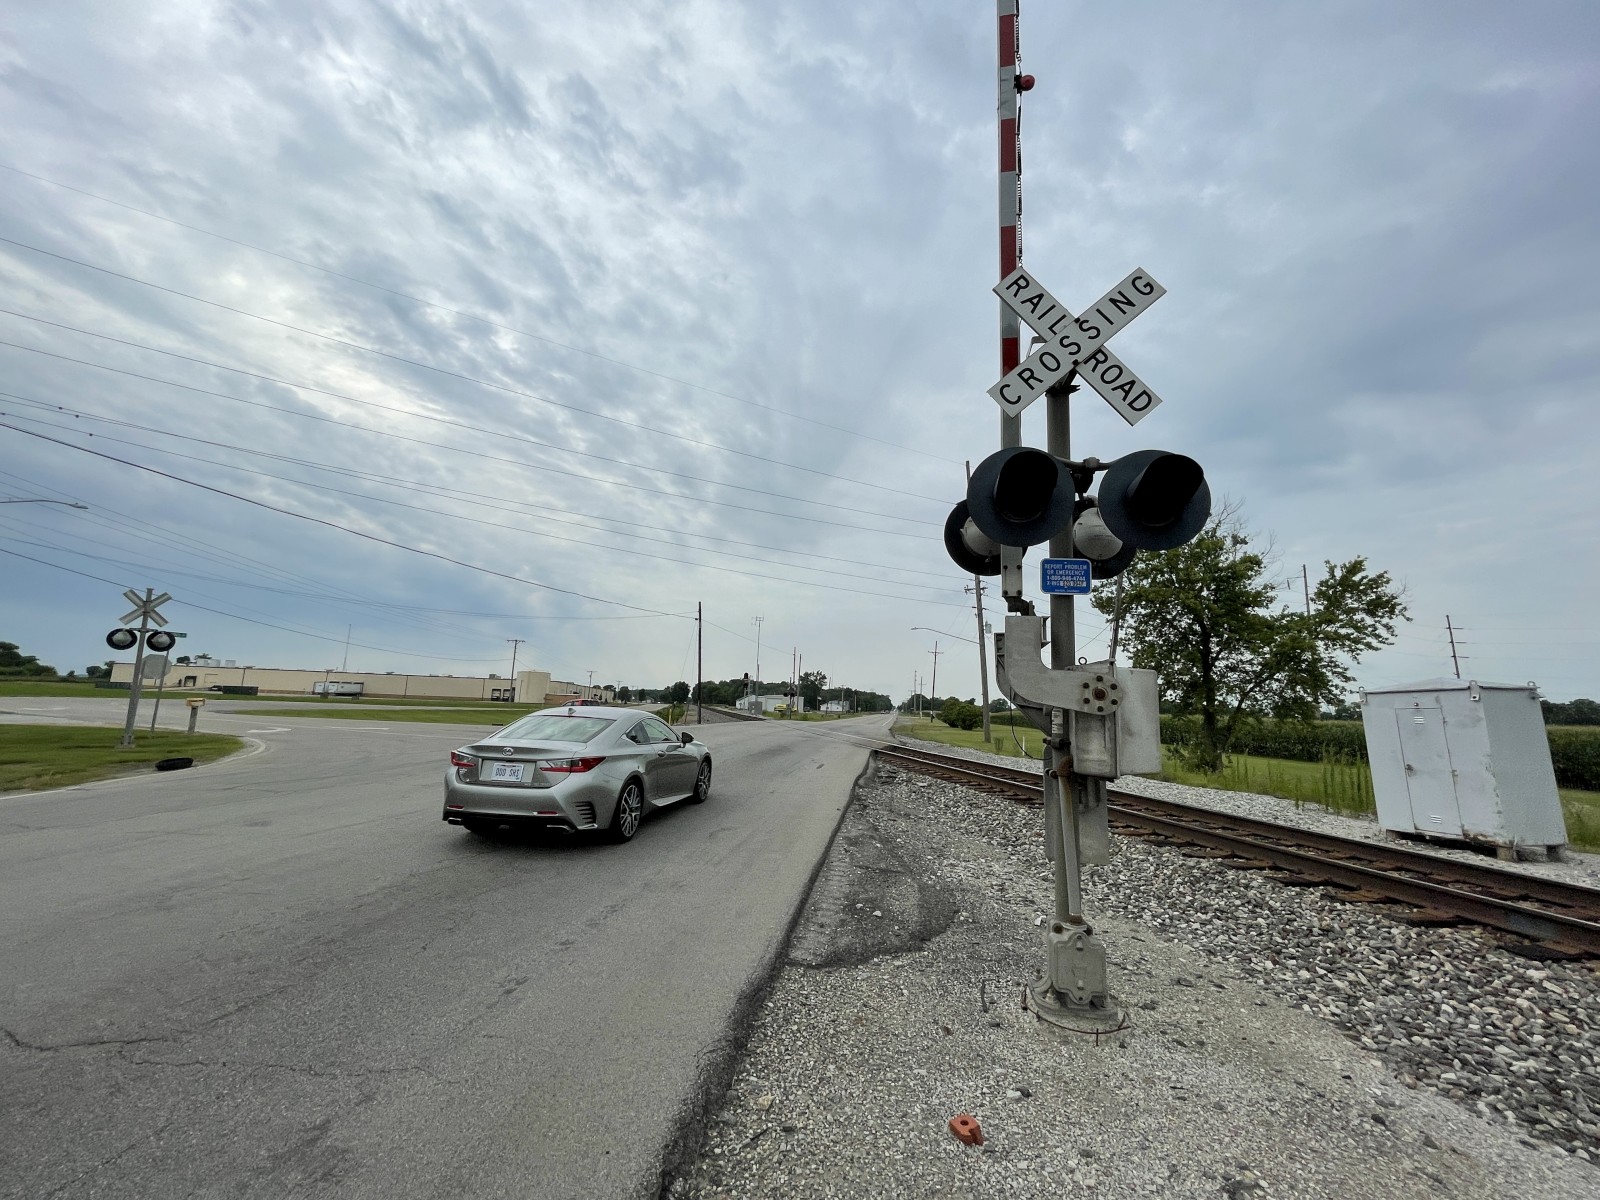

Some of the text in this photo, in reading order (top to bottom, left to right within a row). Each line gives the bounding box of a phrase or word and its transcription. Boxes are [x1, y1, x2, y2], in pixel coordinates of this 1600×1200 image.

[1005, 274, 1066, 335] RAIL
[999, 275, 1154, 405] CROSSING
[1084, 349, 1153, 412] ROAD
